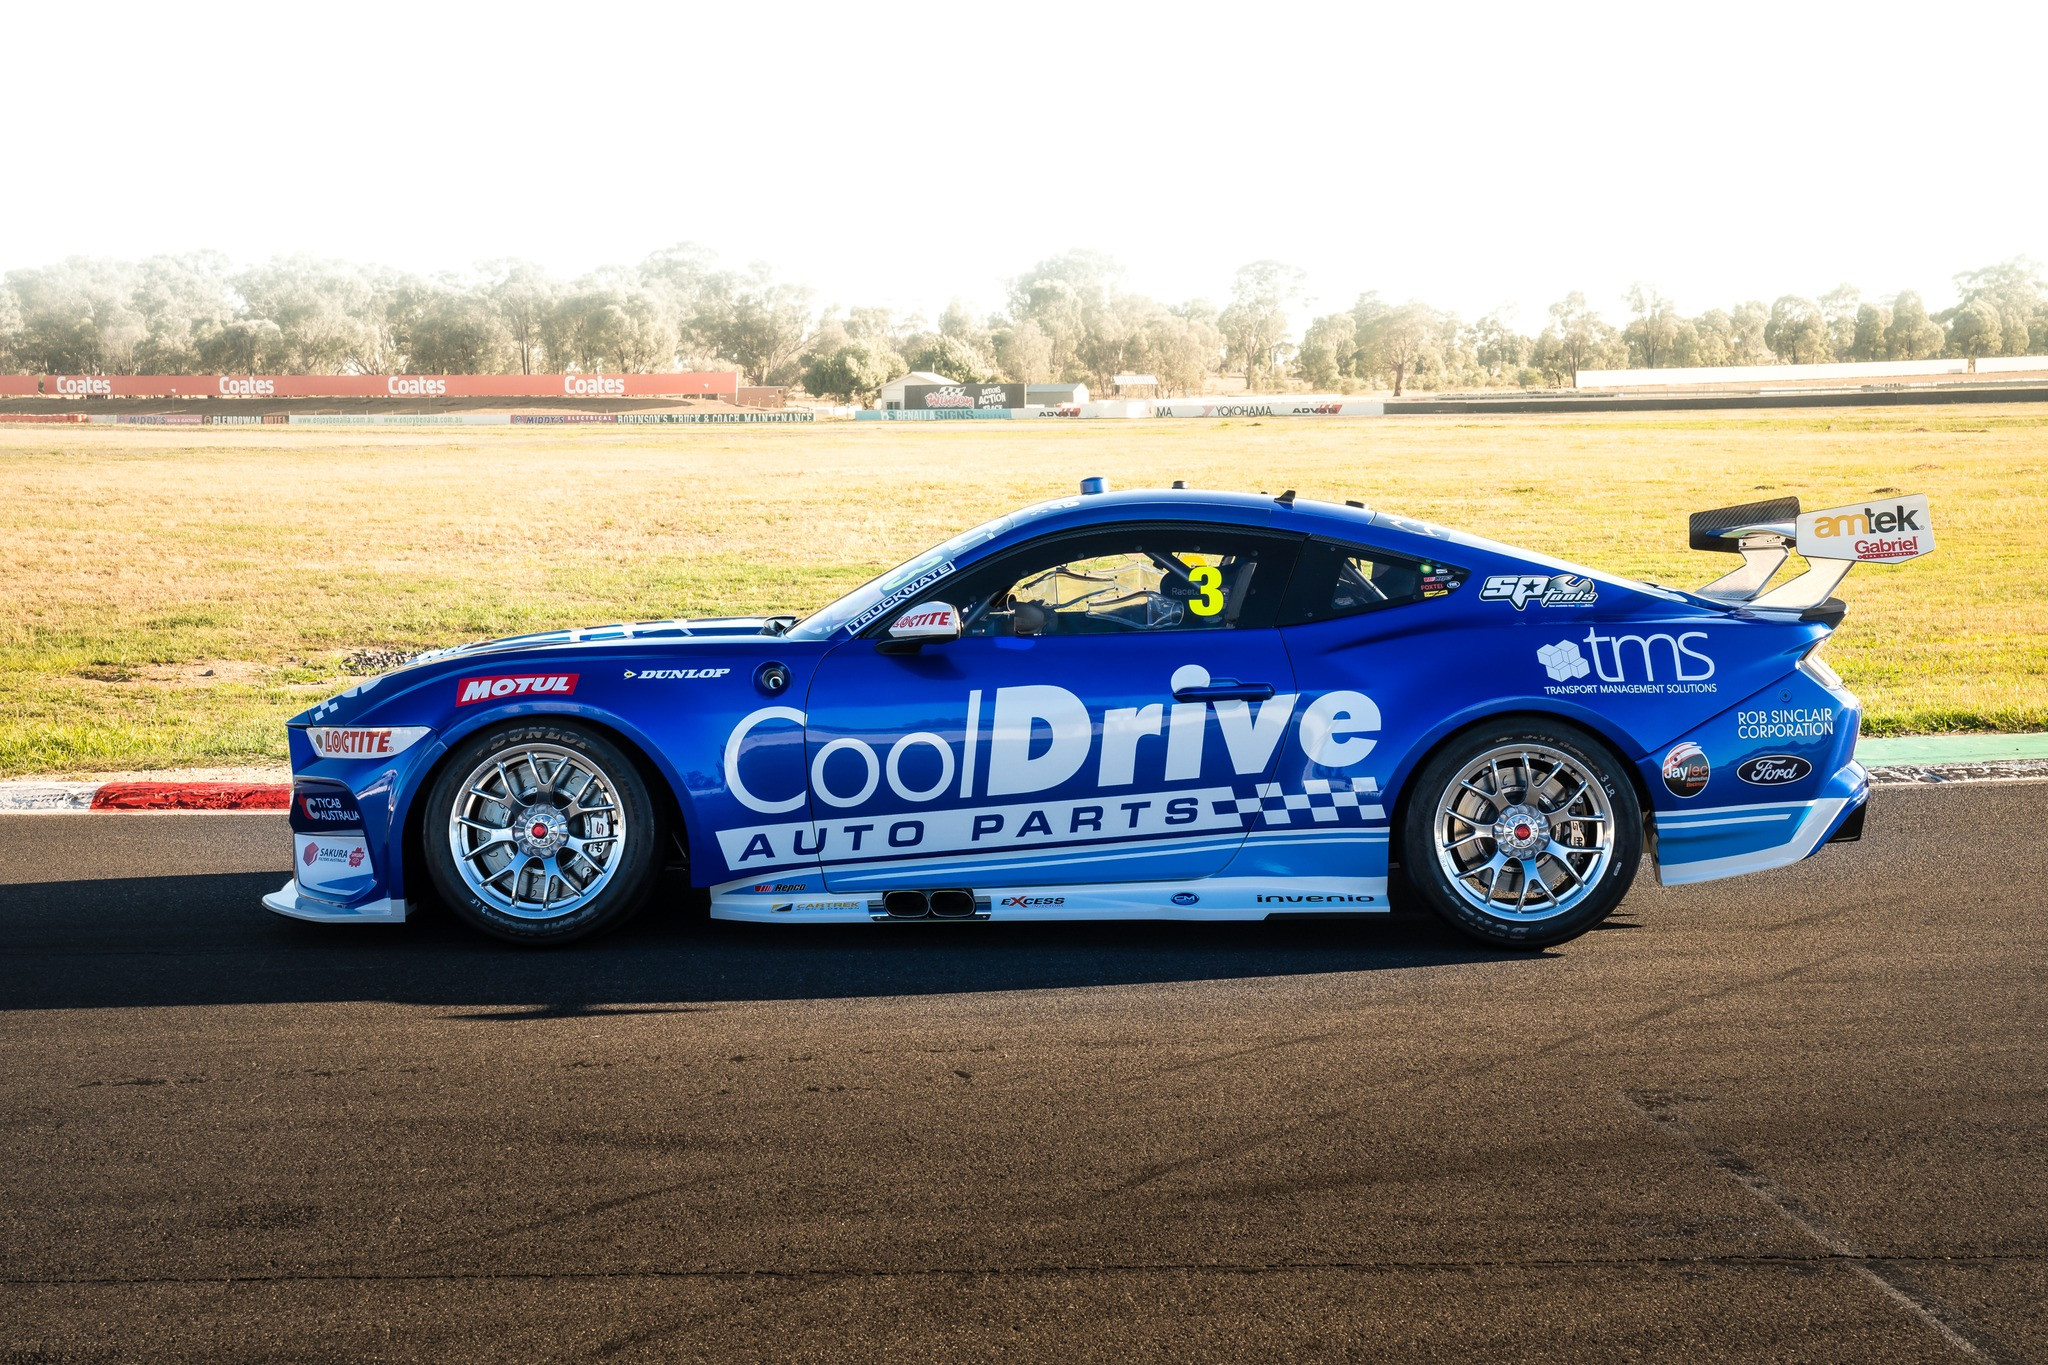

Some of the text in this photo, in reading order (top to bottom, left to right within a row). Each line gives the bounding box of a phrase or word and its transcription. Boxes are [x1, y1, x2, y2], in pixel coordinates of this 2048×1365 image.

[56, 376, 111, 394] Coates
[219, 376, 275, 395] Coates
[387, 375, 446, 395] Coates
[564, 375, 625, 394] Coates
[925, 392, 975, 409] Winton
[978, 392, 1007, 405] ACTION
[617, 413, 813, 424] ROBINSON'S TRUCK & COACH MAINTENANCE
[896, 410, 935, 420] BENALLA
[935, 410, 974, 420] SIGNS
[1216, 405, 1273, 417] YOKOHAMA
[128, 416, 166, 425] MIDDY'S
[212, 416, 262, 425] GLENROWAN
[526, 416, 565, 425] MIDDY'S
[1814, 505, 1920, 539] amtek
[1854, 536, 1918, 554] Gabriel
[849, 564, 950, 630] TRUCKMATE
[1188, 566, 1224, 616] 3
[1541, 588, 1597, 604] tools
[892, 611, 951, 628] LOCTITE
[1583, 627, 1715, 682] tms
[637, 668, 731, 679] DUNLOP
[461, 677, 573, 702] MOTUL
[1544, 683, 1717, 695] TRANSPORT MANAGEMENT SOLUTIONS
[1738, 708, 1833, 725] ROB SINCLAIR
[1738, 722, 1834, 739] CORPORATION
[325, 730, 392, 753] LOCTITE
[723, 664, 1383, 815] CoolDrive
[1664, 763, 1708, 781] Jaylec
[1751, 759, 1798, 781] Ford
[315, 798, 342, 809] TYCAB
[320, 810, 360, 821] AUSTRALIA
[738, 800, 1199, 863] AUTO PARTS
[320, 848, 348, 858] SAKURA
[774, 884, 806, 893] Repco
[796, 901, 860, 909] CARTREK
[1001, 895, 1065, 908] EXCESS
[1256, 894, 1375, 903] invenio
